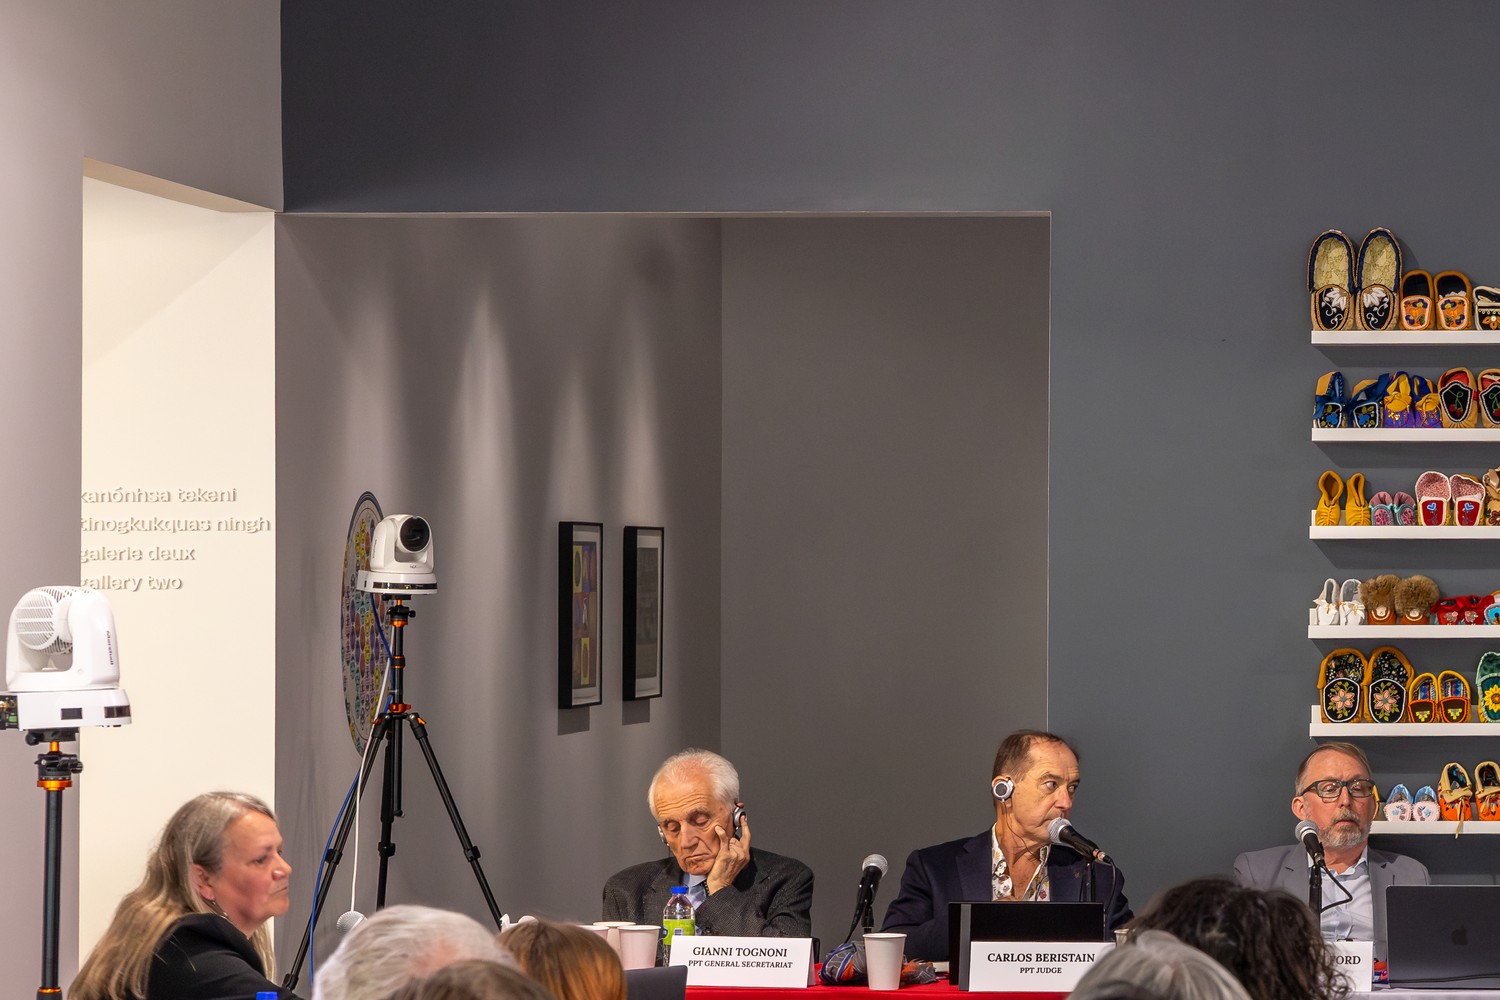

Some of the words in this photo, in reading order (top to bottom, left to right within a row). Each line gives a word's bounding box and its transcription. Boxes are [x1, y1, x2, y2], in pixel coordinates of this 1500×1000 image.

[178, 488, 238, 502] tekeni
[217, 517, 271, 534] ningh
[149, 546, 196, 561] deux
[149, 576, 183, 590] two
[692, 947, 733, 957] GIANNI
[735, 947, 788, 957] TOGNONI
[987, 953, 1032, 962] CARLOS
[1035, 953, 1095, 963] BERISTAIN
[704, 960, 740, 968] GENERAL
[741, 961, 793, 969] SECRETARIAT
